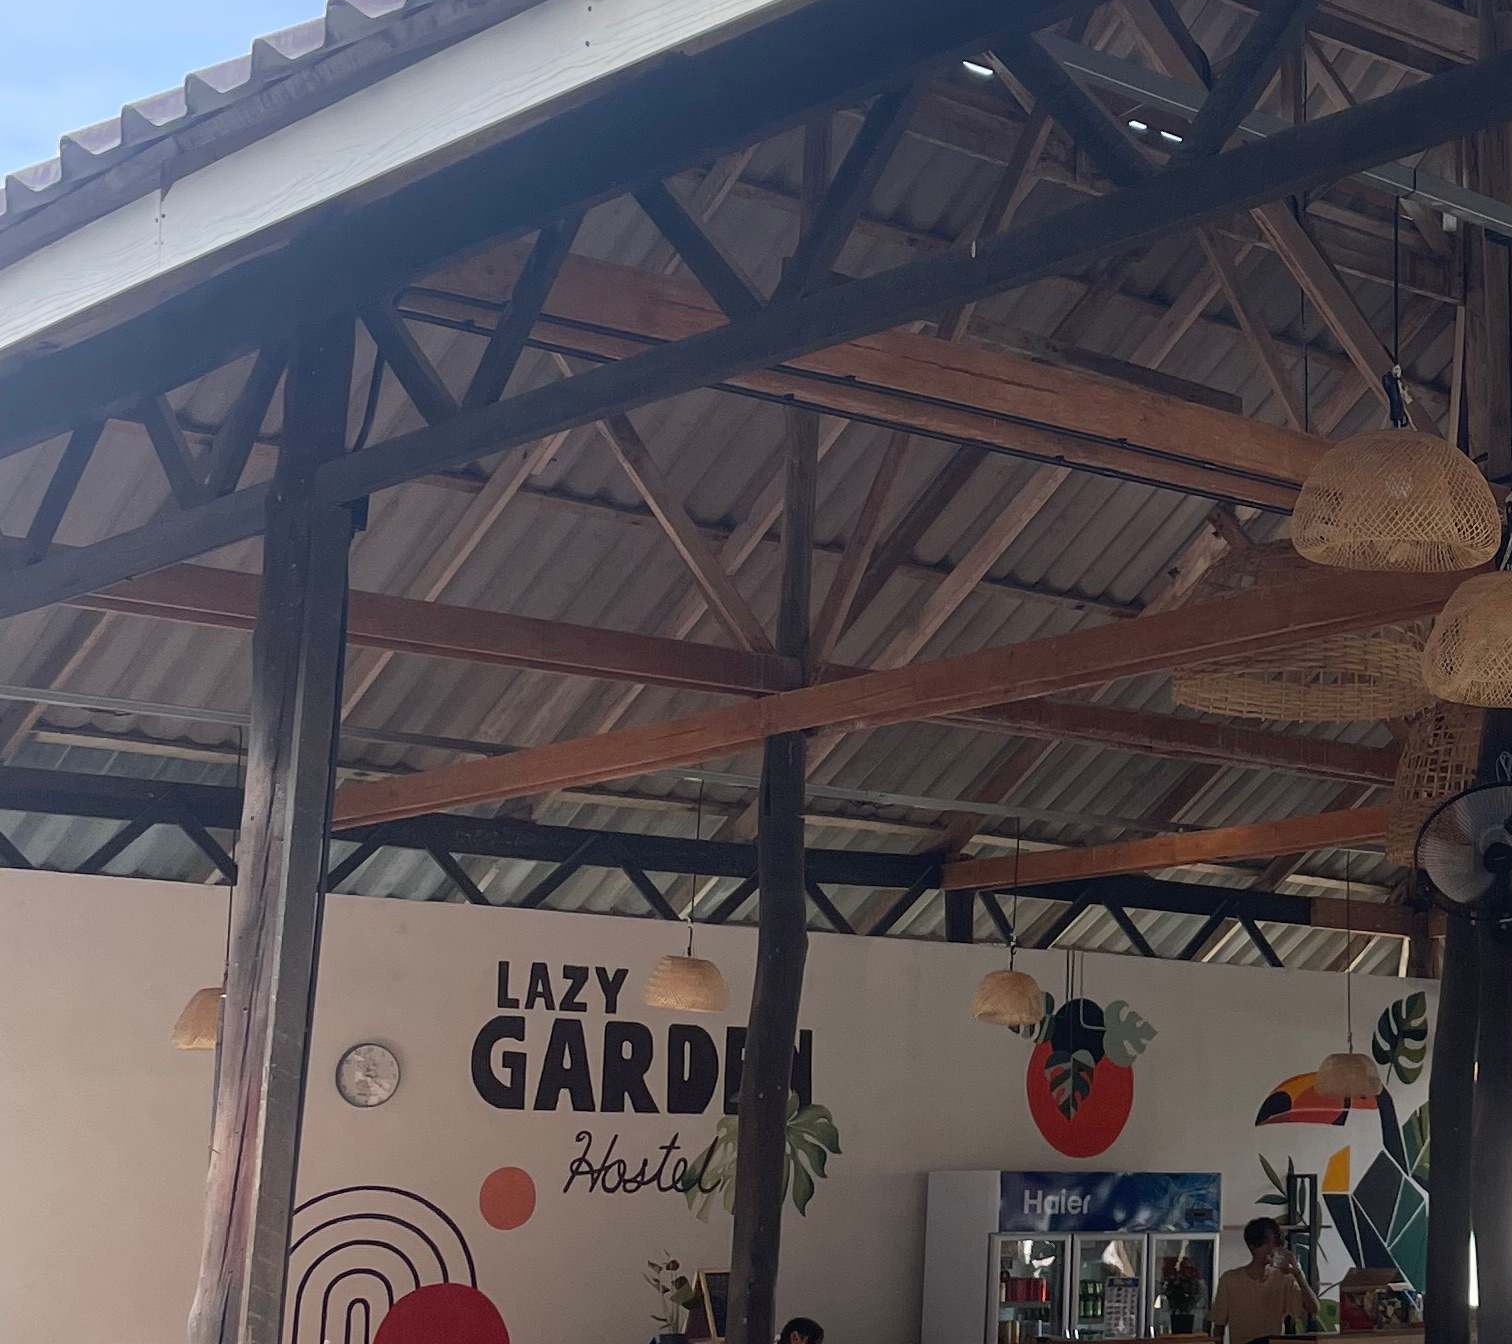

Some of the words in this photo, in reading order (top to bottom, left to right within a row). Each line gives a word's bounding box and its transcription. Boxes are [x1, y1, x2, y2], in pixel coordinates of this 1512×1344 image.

[497, 960, 629, 1014] LAZY
[563, 1130, 724, 1194] Hostel
[1023, 1188, 1092, 1215] Haier
